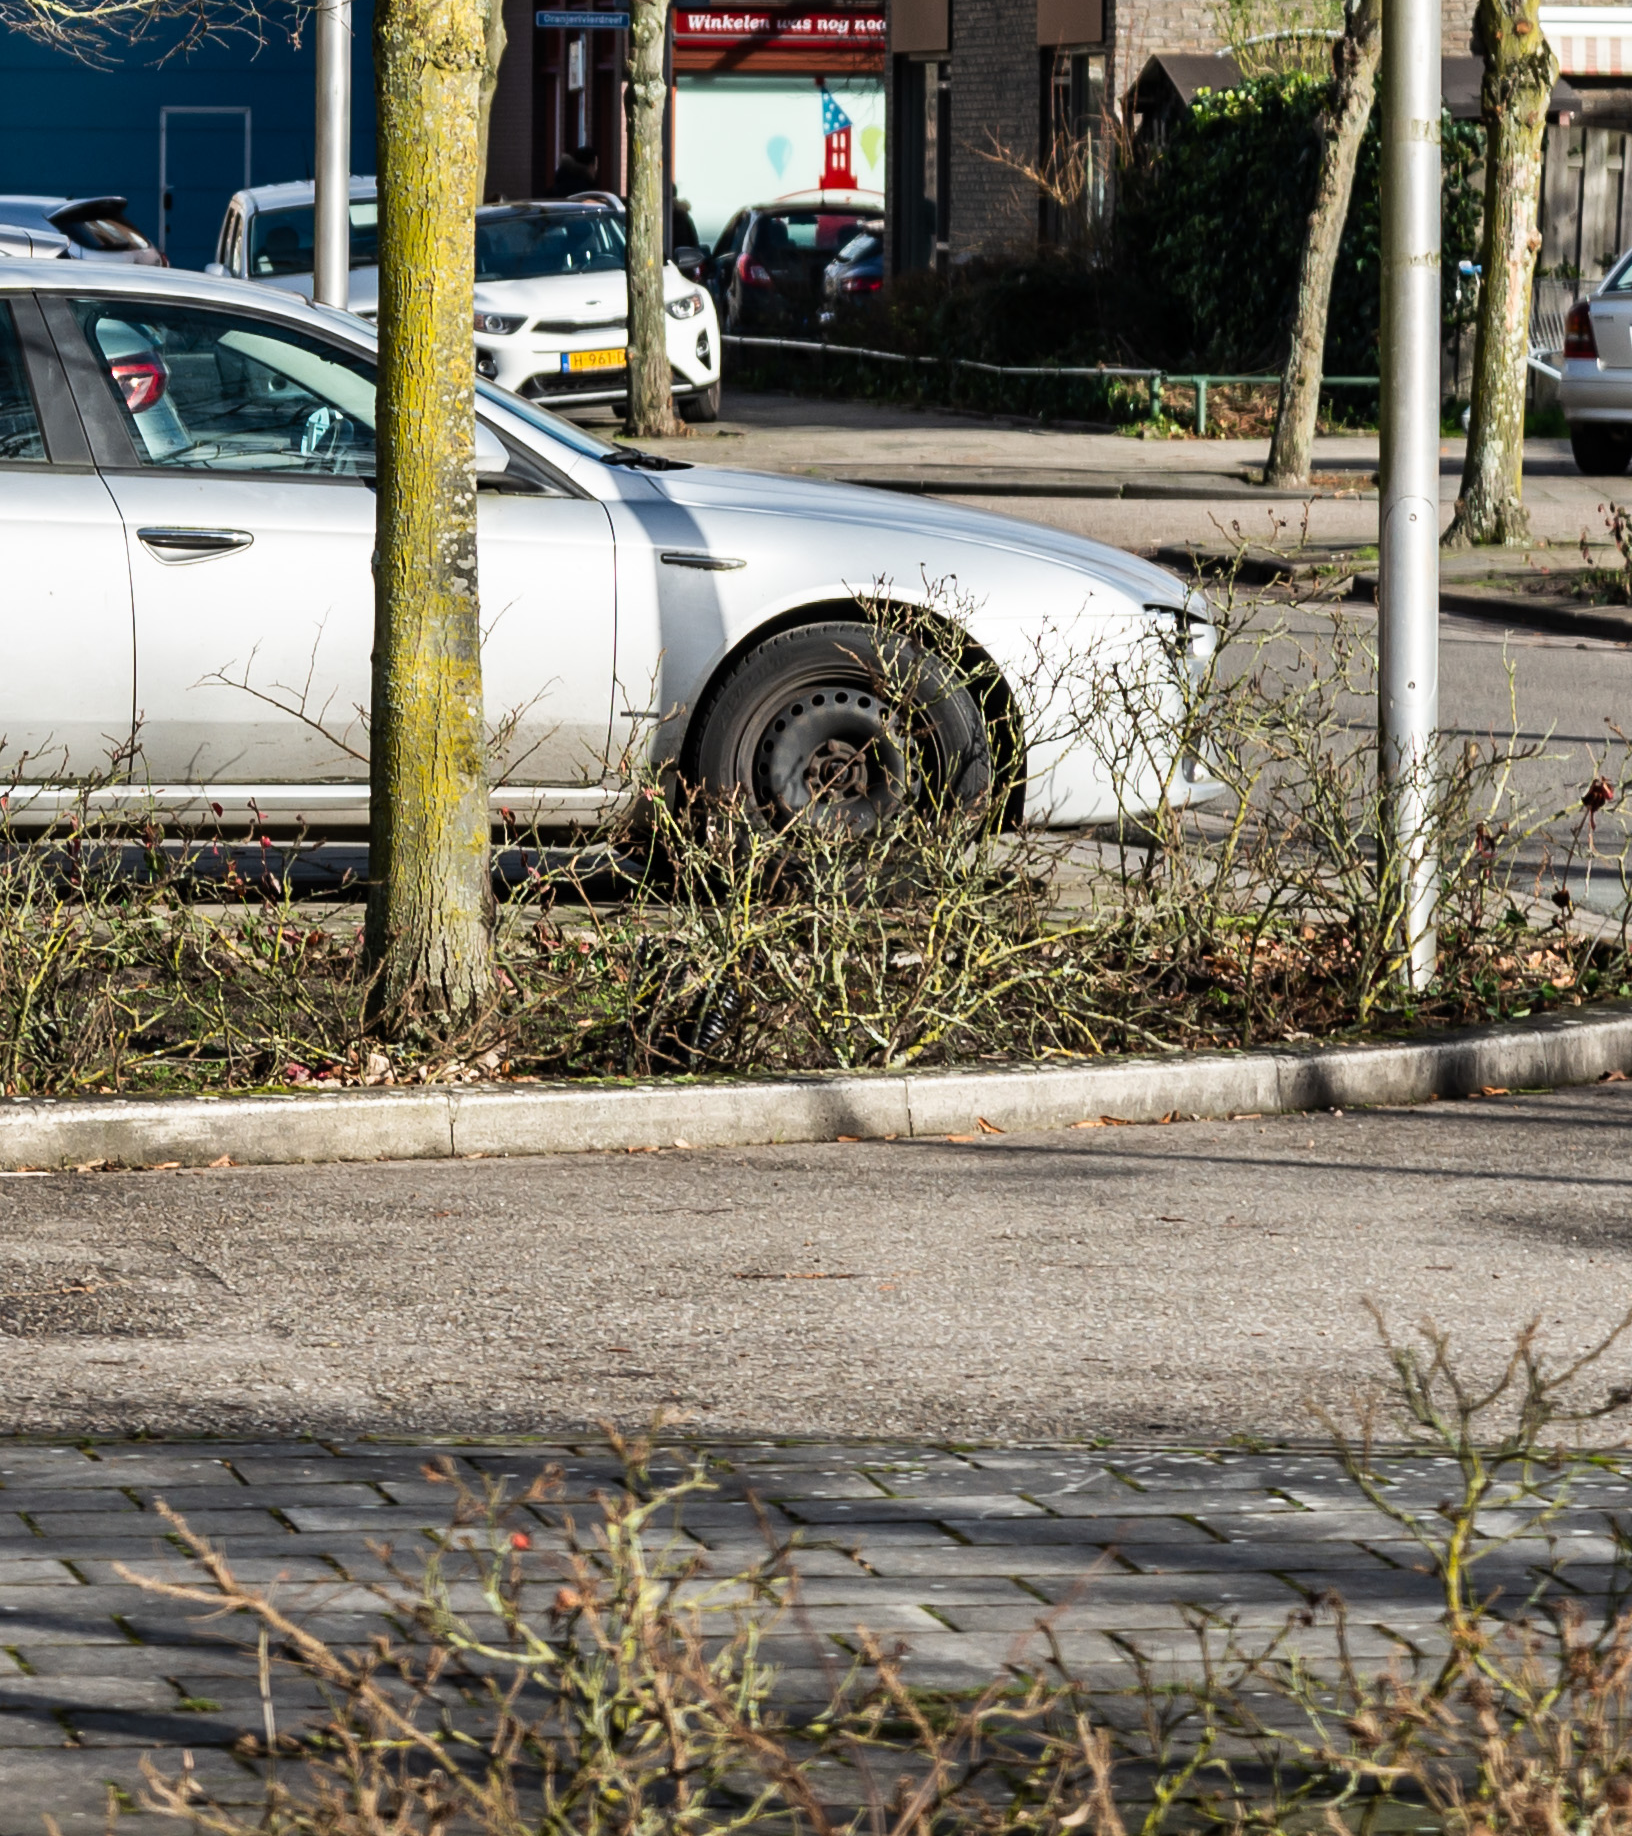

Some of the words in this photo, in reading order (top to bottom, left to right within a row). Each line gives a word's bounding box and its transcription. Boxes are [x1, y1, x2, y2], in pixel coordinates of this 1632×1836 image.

[687, 14, 770, 31] Winkelen
[777, 18, 812, 31] was
[817, 18, 850, 34] nog
